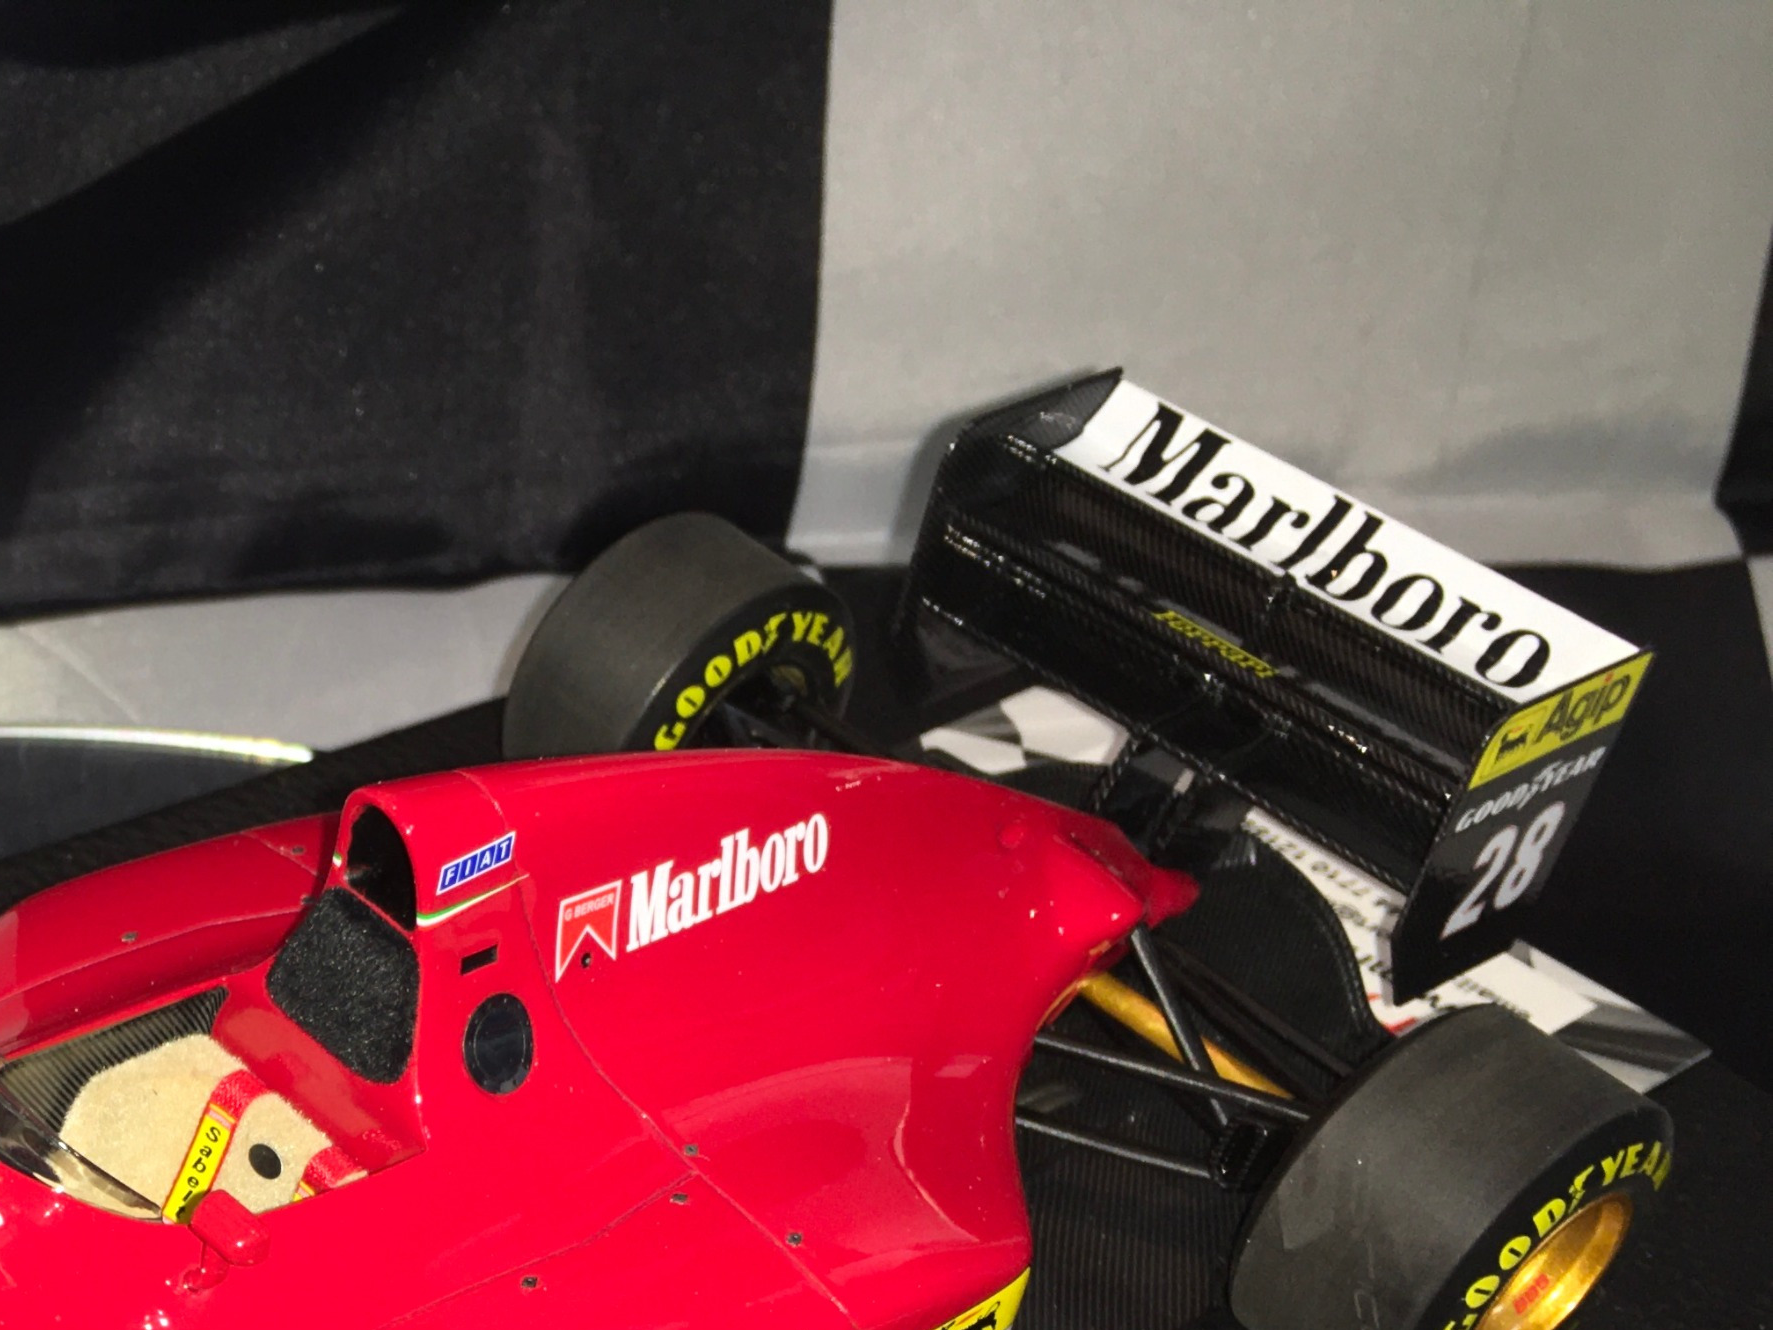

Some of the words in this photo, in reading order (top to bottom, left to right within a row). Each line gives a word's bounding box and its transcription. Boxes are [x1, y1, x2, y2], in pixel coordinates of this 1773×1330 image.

[1101, 402, 1552, 690] Marlboro
[653, 610, 854, 751] GOODYEAR
[1533, 673, 1632, 741] Agip
[1455, 746, 1607, 834] GOODYEAR
[441, 836, 515, 890] FIAT
[626, 812, 828, 953] Marlboro
[1439, 800, 1566, 941] 28
[173, 1125, 223, 1222] Sabelt
